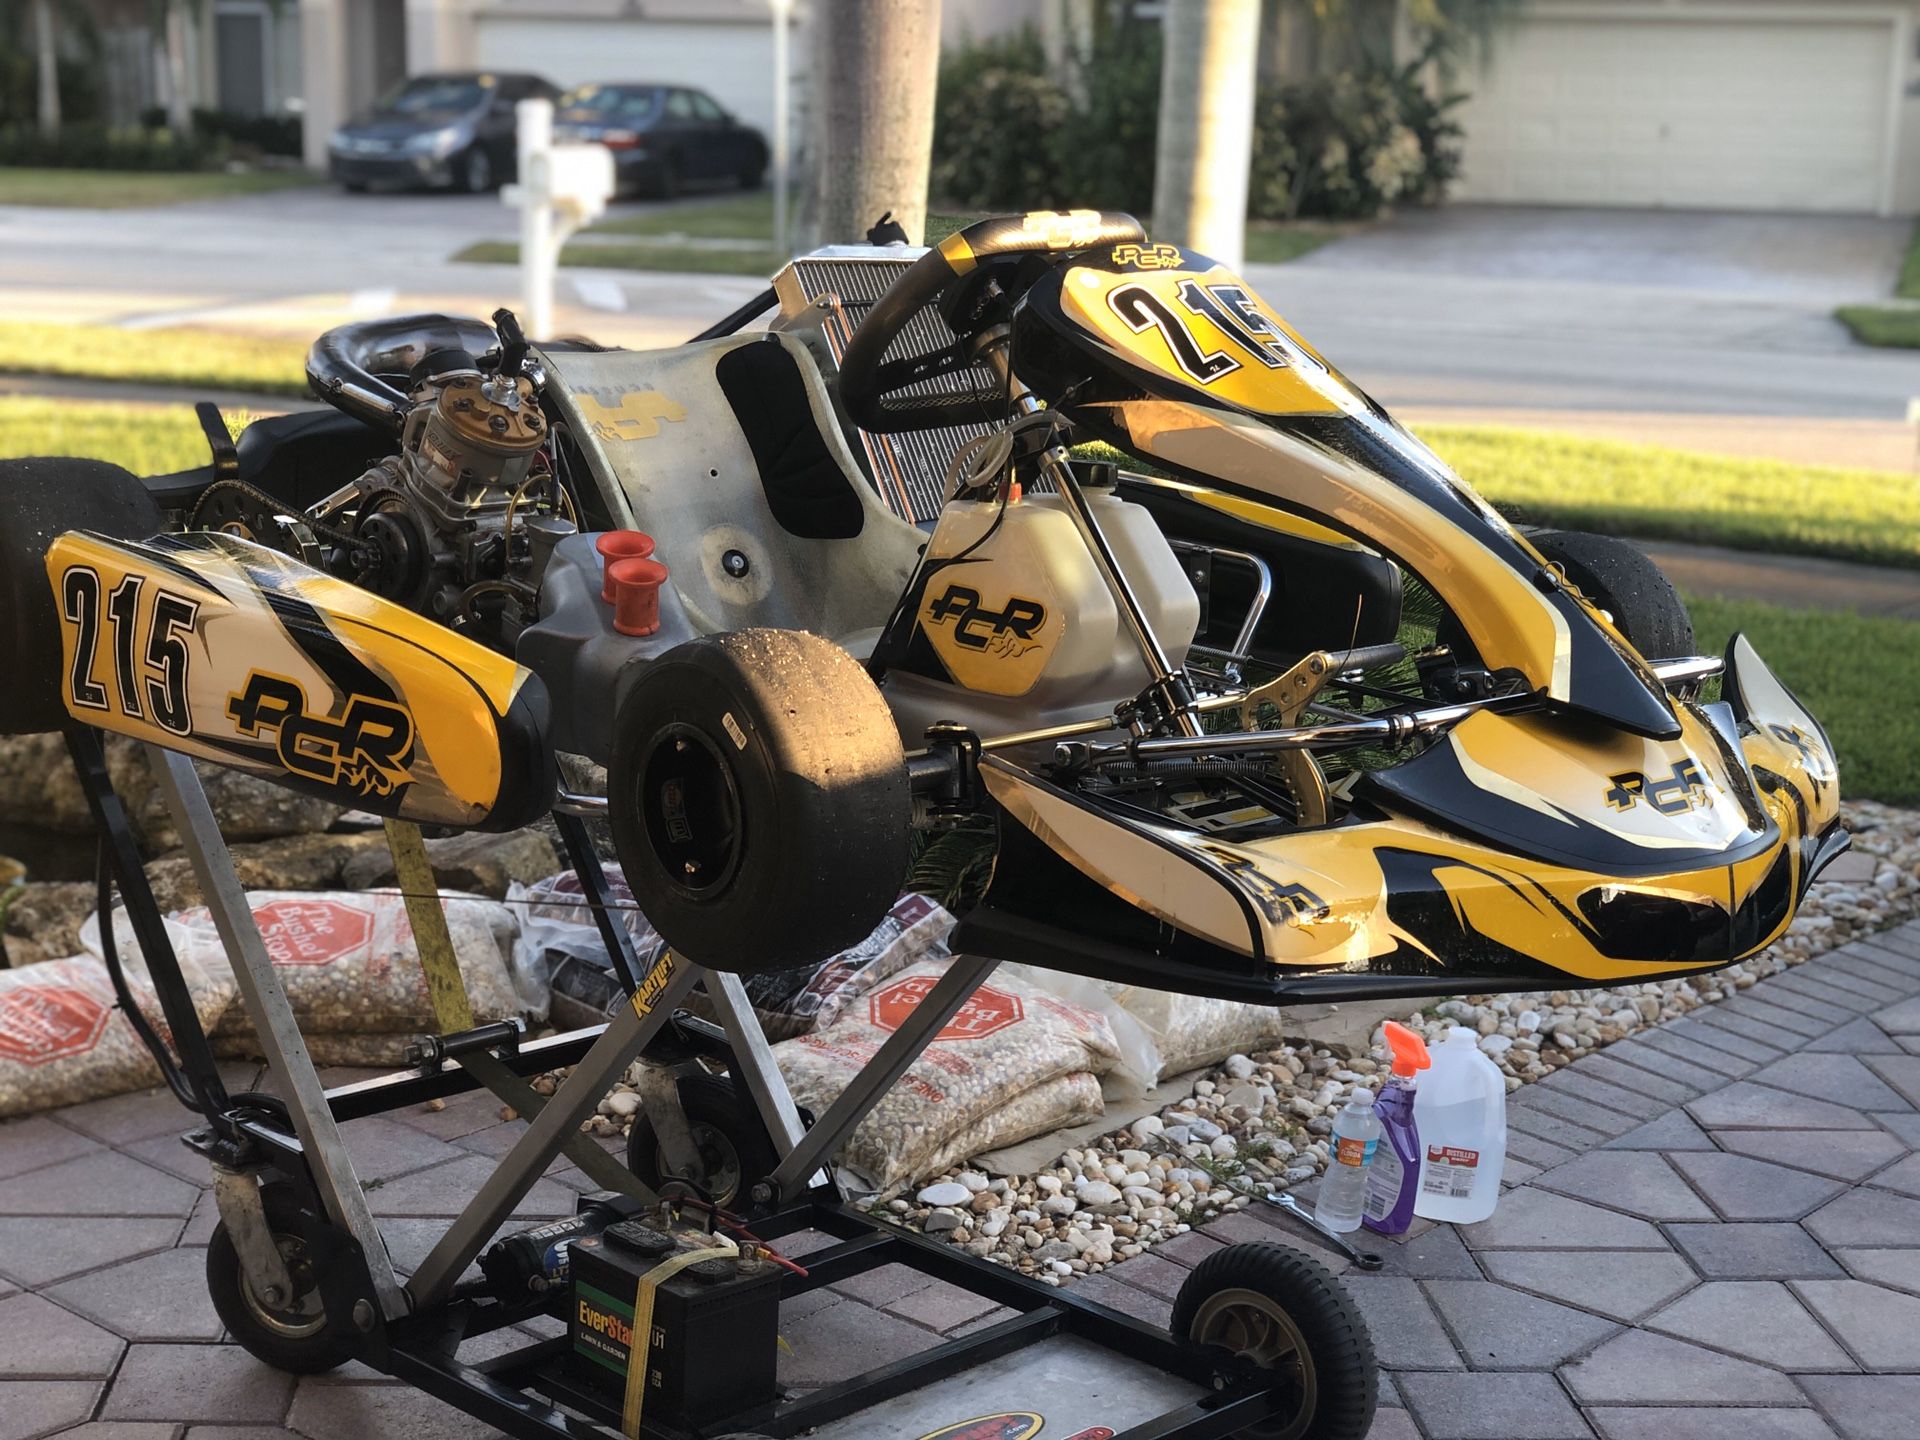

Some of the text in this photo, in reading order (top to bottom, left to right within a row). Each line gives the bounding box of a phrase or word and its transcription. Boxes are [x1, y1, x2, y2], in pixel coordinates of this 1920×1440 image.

[1112, 244, 1181, 269] PCR
[1106, 278, 1329, 385] 215
[929, 584, 1046, 650] PCR
[61, 565, 200, 738] 215
[226, 668, 416, 787] PCR
[274, 906, 329, 958] Bushel
[303, 905, 335, 935] The
[257, 922, 293, 964] Stop
[631, 951, 674, 1020] KARTLIFT
[889, 990, 1002, 1022] Buel
[1446, 1148, 1477, 1160] DISTILLED
[579, 1300, 634, 1347] EverSta
[652, 1328, 665, 1350] U1
[1006, 1423, 1029, 1436] .com
